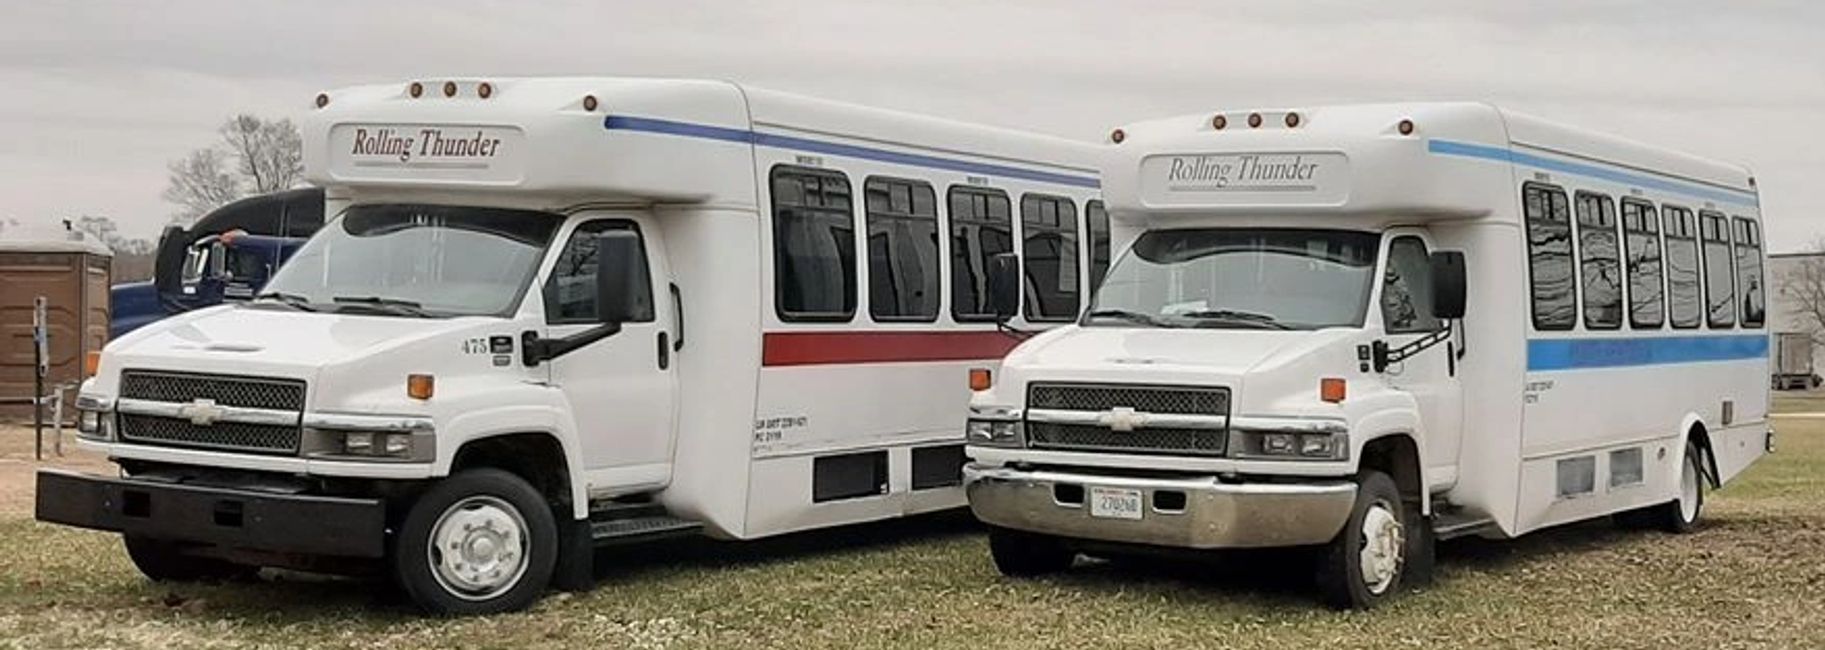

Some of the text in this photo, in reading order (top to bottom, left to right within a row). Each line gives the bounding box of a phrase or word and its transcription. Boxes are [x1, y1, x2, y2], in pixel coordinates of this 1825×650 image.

[353, 128, 500, 162] Rolling Thunder
[1168, 155, 1319, 188] Rolling Thunder
[461, 338, 487, 354] 475
